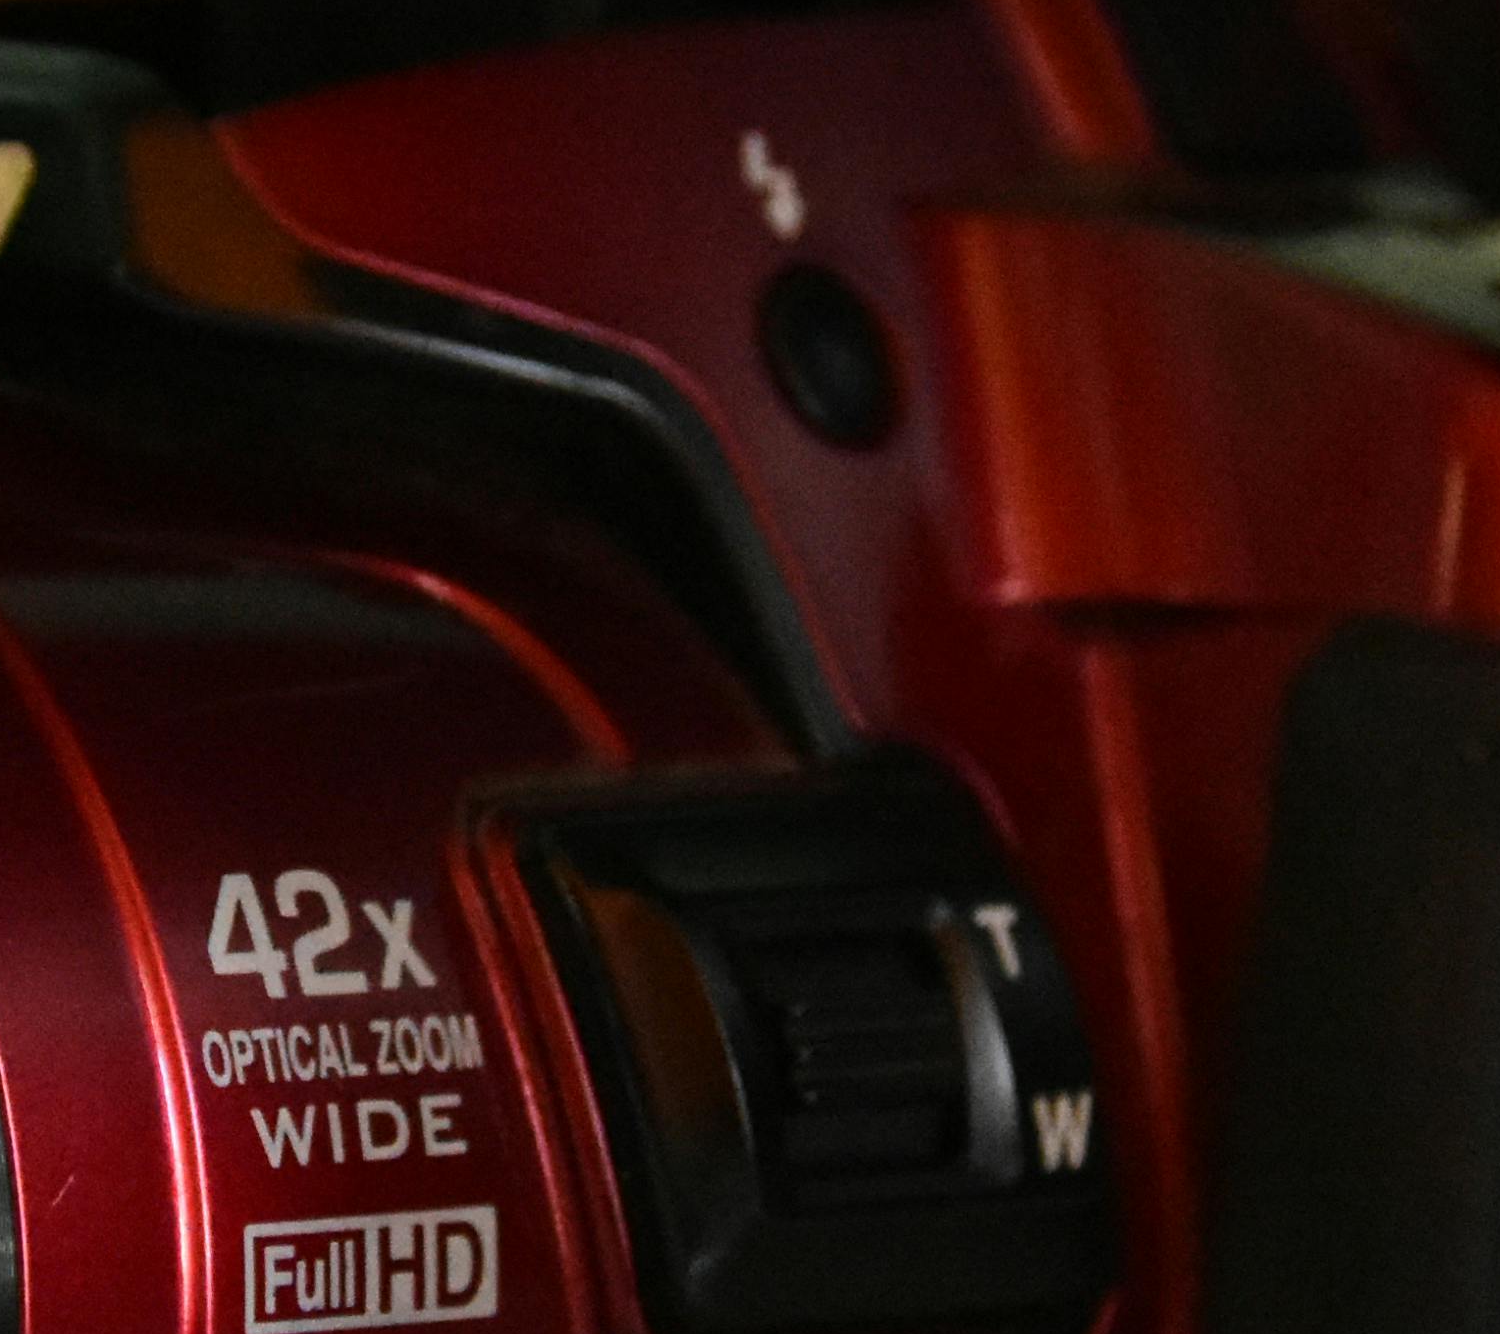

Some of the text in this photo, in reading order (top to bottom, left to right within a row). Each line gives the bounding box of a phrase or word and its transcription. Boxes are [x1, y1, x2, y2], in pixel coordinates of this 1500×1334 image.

[973, 903, 1023, 982] T
[202, 1013, 484, 1088] OPTICAL ZOOM
[250, 1093, 468, 1169] WIDE
[1032, 1090, 1093, 1174] W
